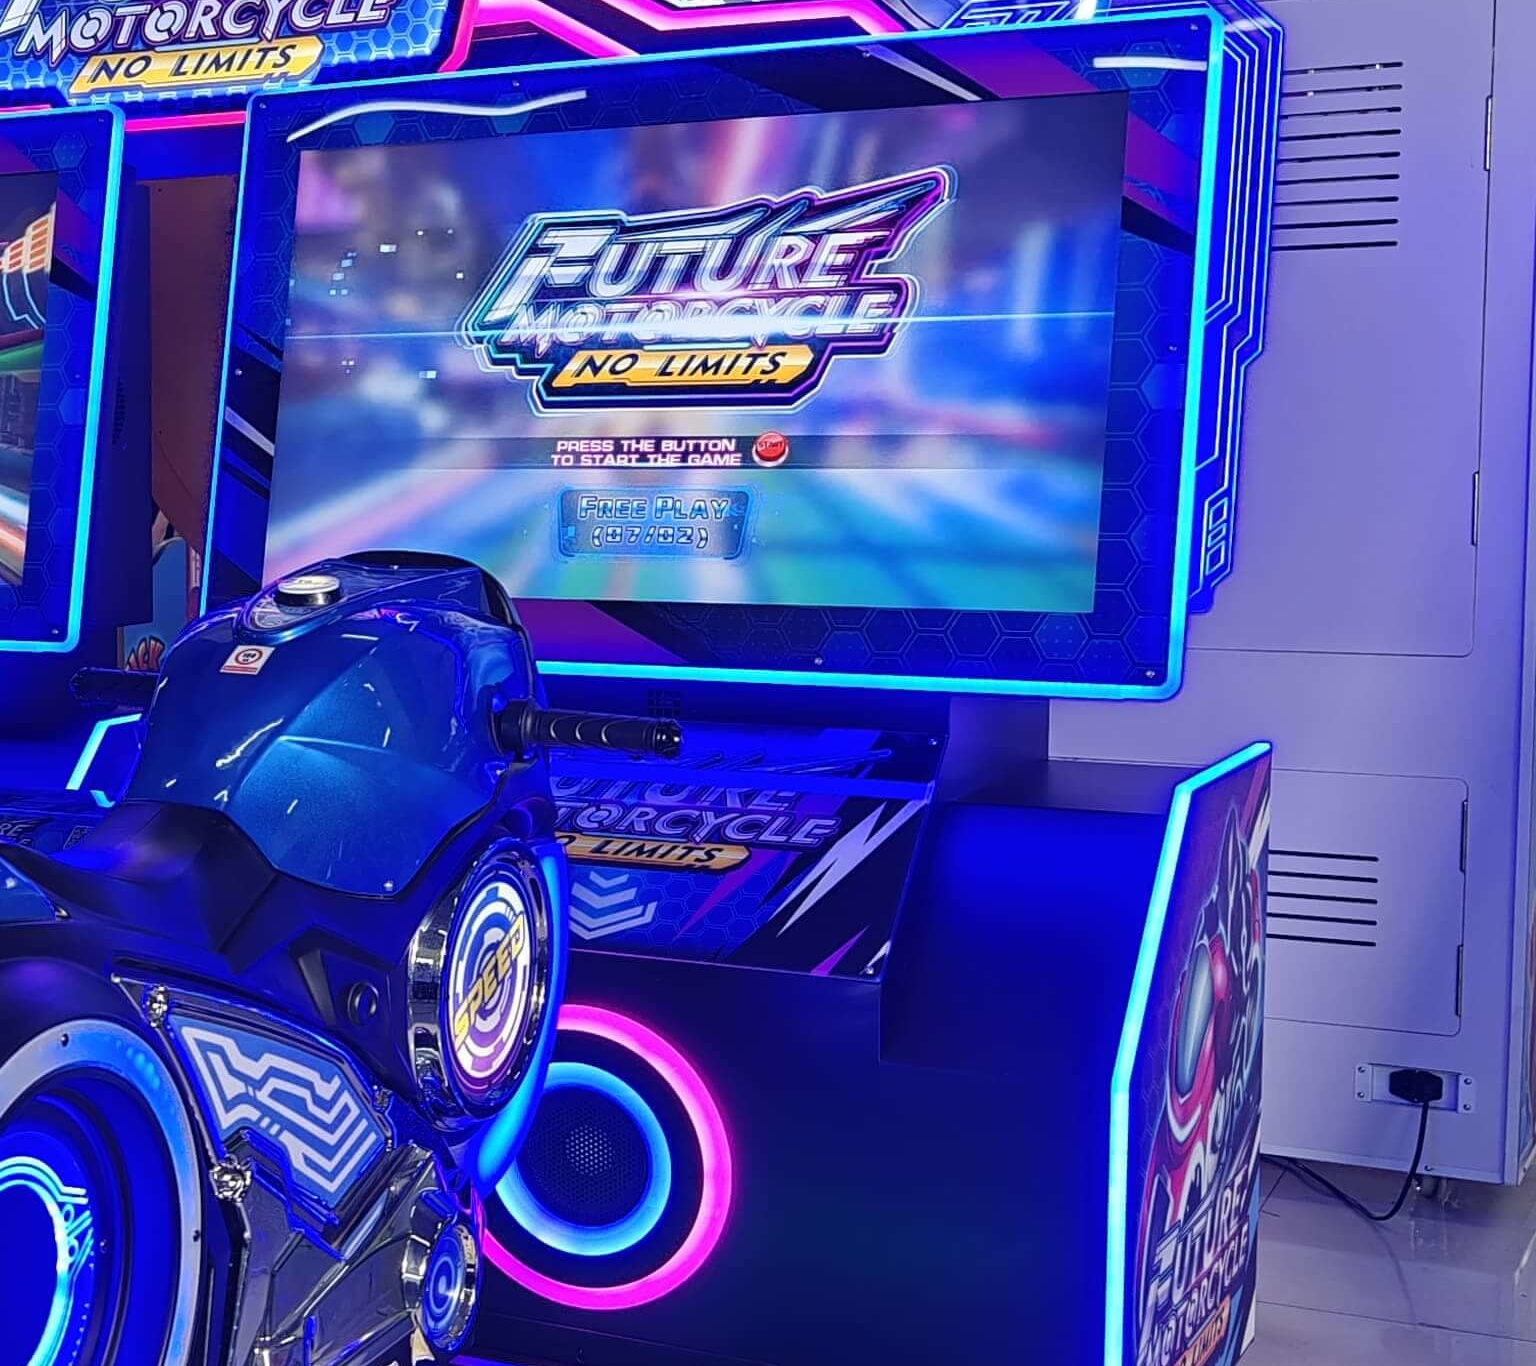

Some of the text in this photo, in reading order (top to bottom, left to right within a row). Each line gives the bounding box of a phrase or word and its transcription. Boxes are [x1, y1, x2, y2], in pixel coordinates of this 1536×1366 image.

[92, 45, 296, 83] NO LIMITS
[483, 195, 916, 323] FUTURE
[499, 292, 898, 356] MOTORCYCLE
[575, 351, 787, 378] NO LIMITS
[556, 438, 736, 452] PRESS THE BUTTON
[551, 453, 742, 466] TO START THE GAME
[578, 495, 729, 520] FREE PLAY
[590, 525, 710, 549] (07/02)
[591, 838, 724, 864] LIMITS
[453, 911, 526, 1050] SPEED
